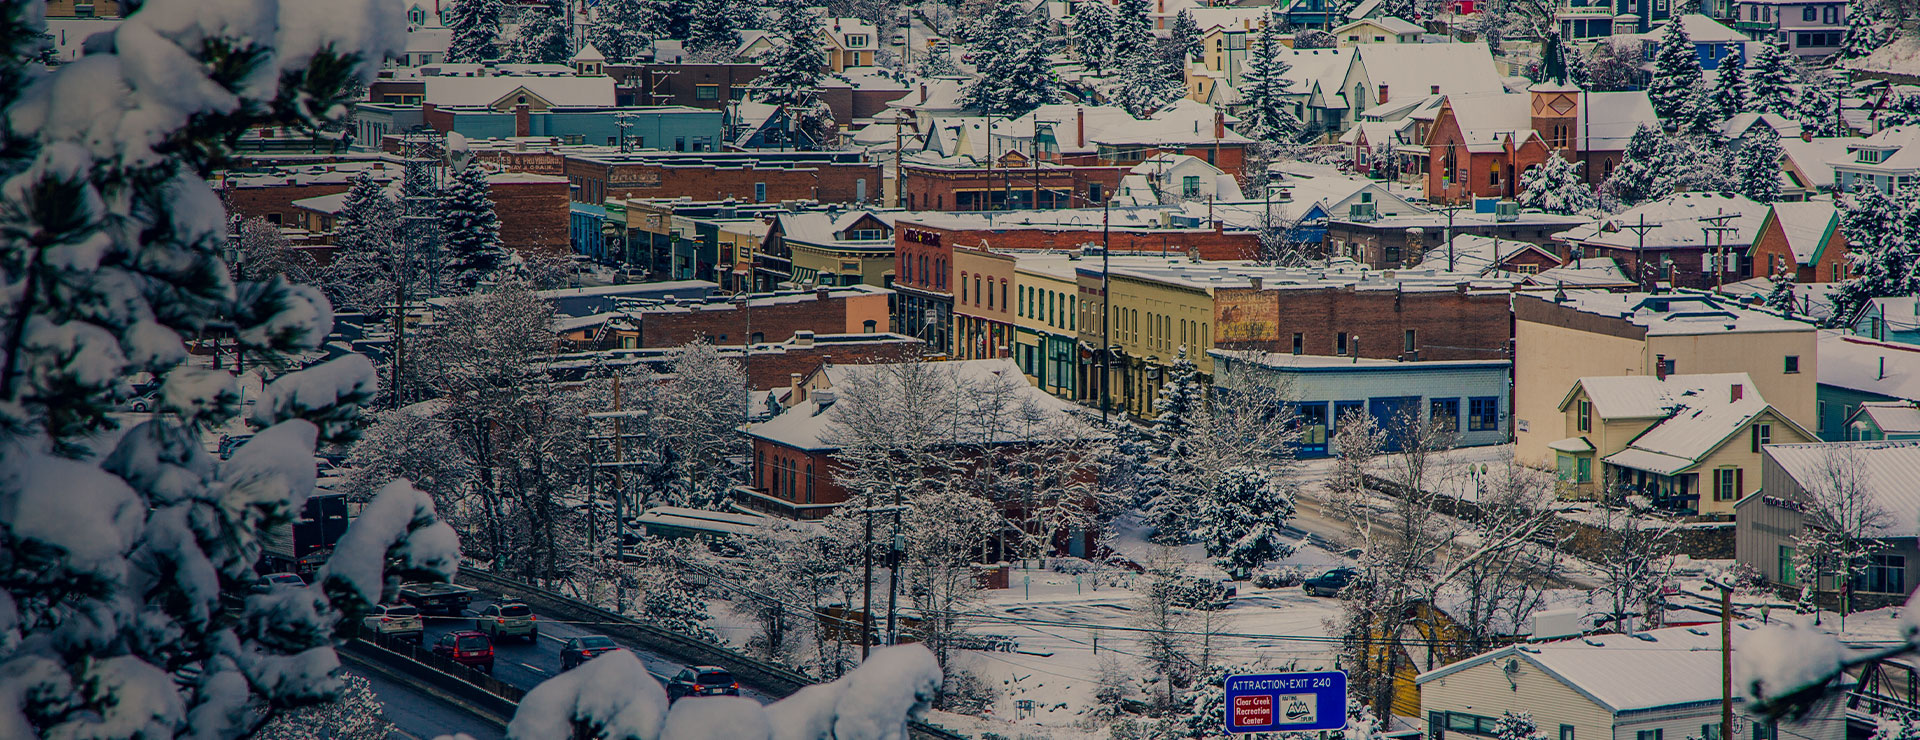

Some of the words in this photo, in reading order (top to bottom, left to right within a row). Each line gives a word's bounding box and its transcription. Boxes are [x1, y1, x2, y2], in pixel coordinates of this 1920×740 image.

[1312, 678, 1331, 688] 240
[1236, 698, 1252, 706] Clear
[1253, 697, 1270, 706] Creek
[1236, 707, 1270, 716] Recreation
[1287, 702, 1309, 713] AVA
[1242, 716, 1264, 725] Center
